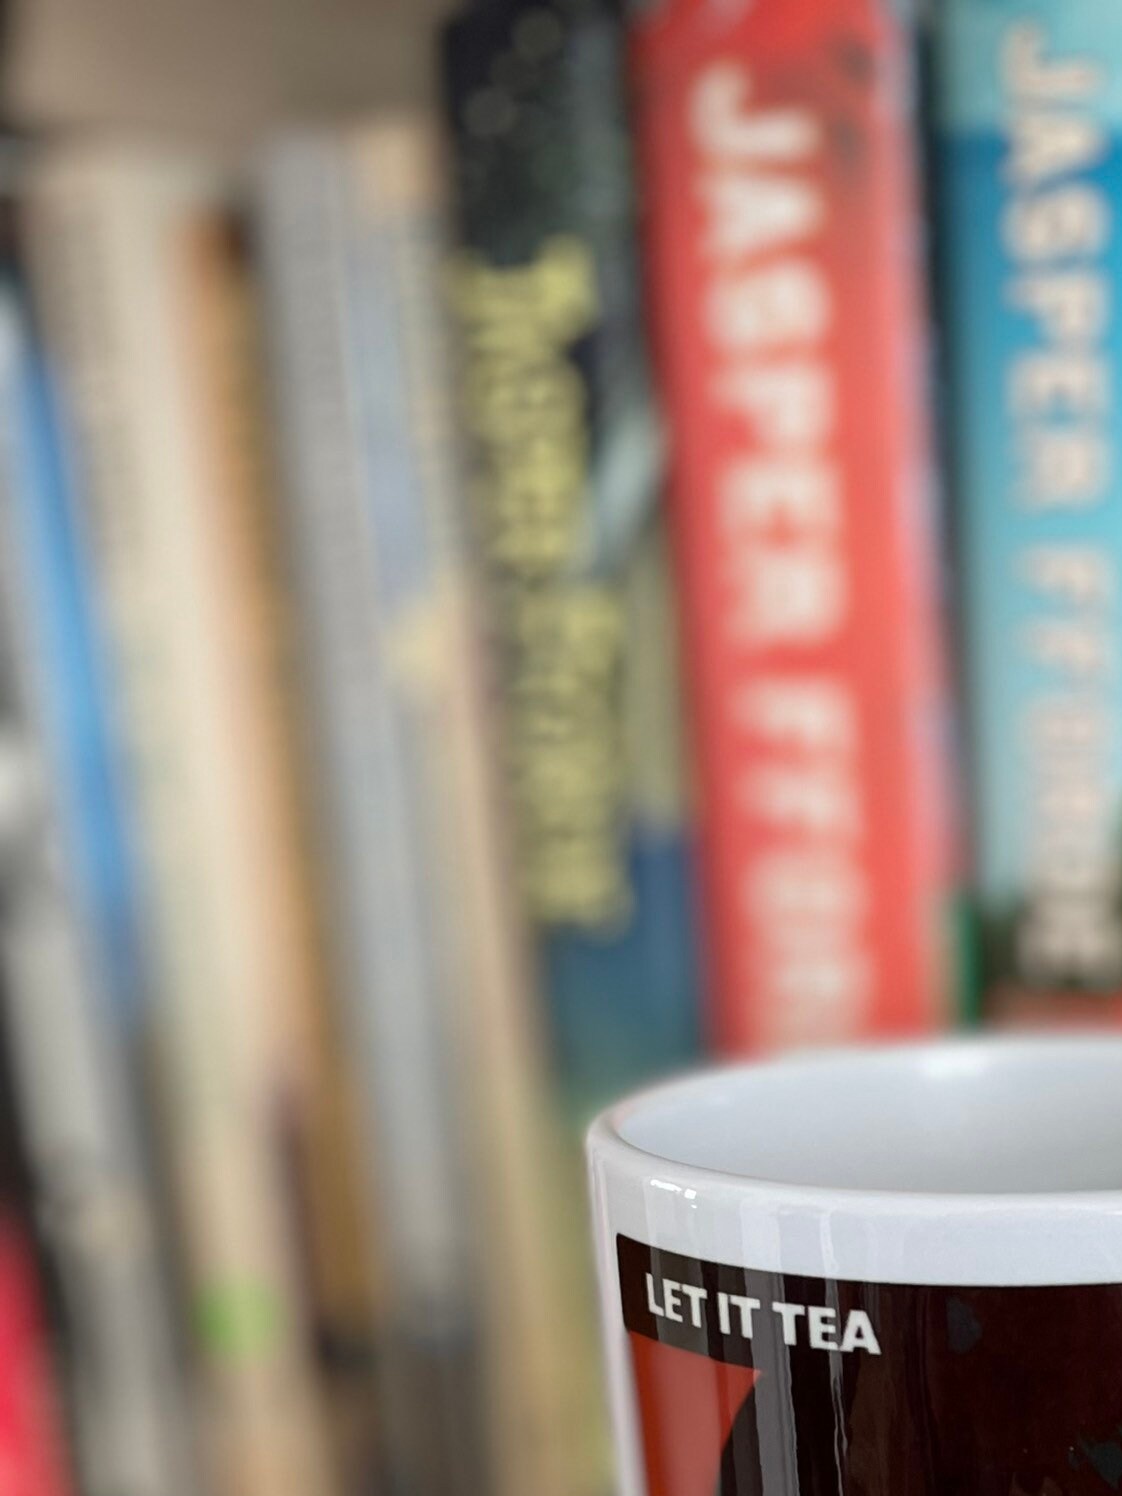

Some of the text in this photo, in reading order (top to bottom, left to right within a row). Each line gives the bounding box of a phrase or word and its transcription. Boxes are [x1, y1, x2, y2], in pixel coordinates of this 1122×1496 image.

[691, 65, 848, 647] JASPER
[998, 22, 1113, 512] JASPER
[645, 1272, 882, 1356] LET IT TEA
